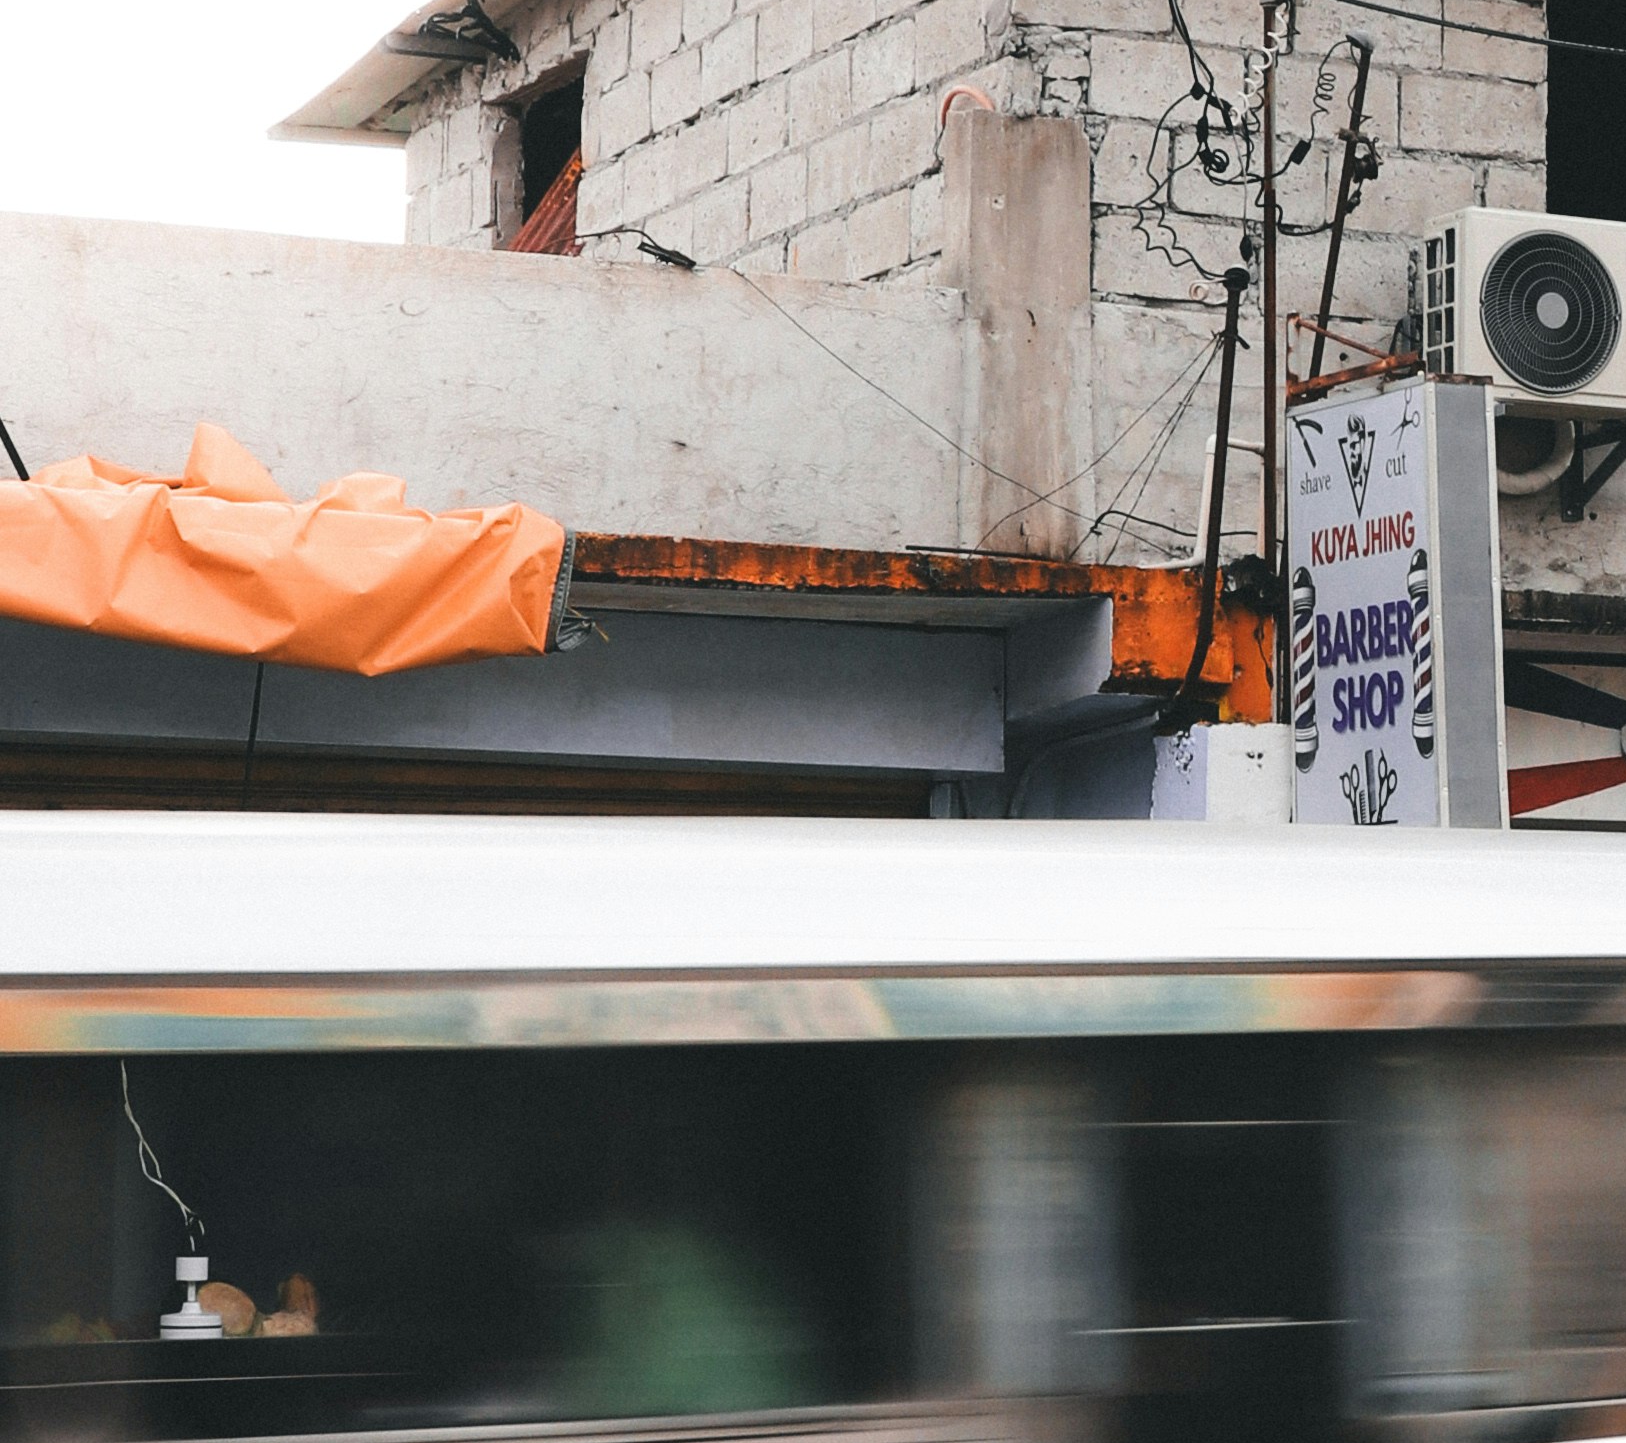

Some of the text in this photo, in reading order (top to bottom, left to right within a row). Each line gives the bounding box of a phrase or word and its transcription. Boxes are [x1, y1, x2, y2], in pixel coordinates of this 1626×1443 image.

[1300, 472, 1331, 496] shave
[1386, 452, 1407, 478] cut
[1312, 511, 1415, 567] KUYA JHING
[1316, 600, 1415, 668] BARBER
[1332, 670, 1404, 733] SHOP
